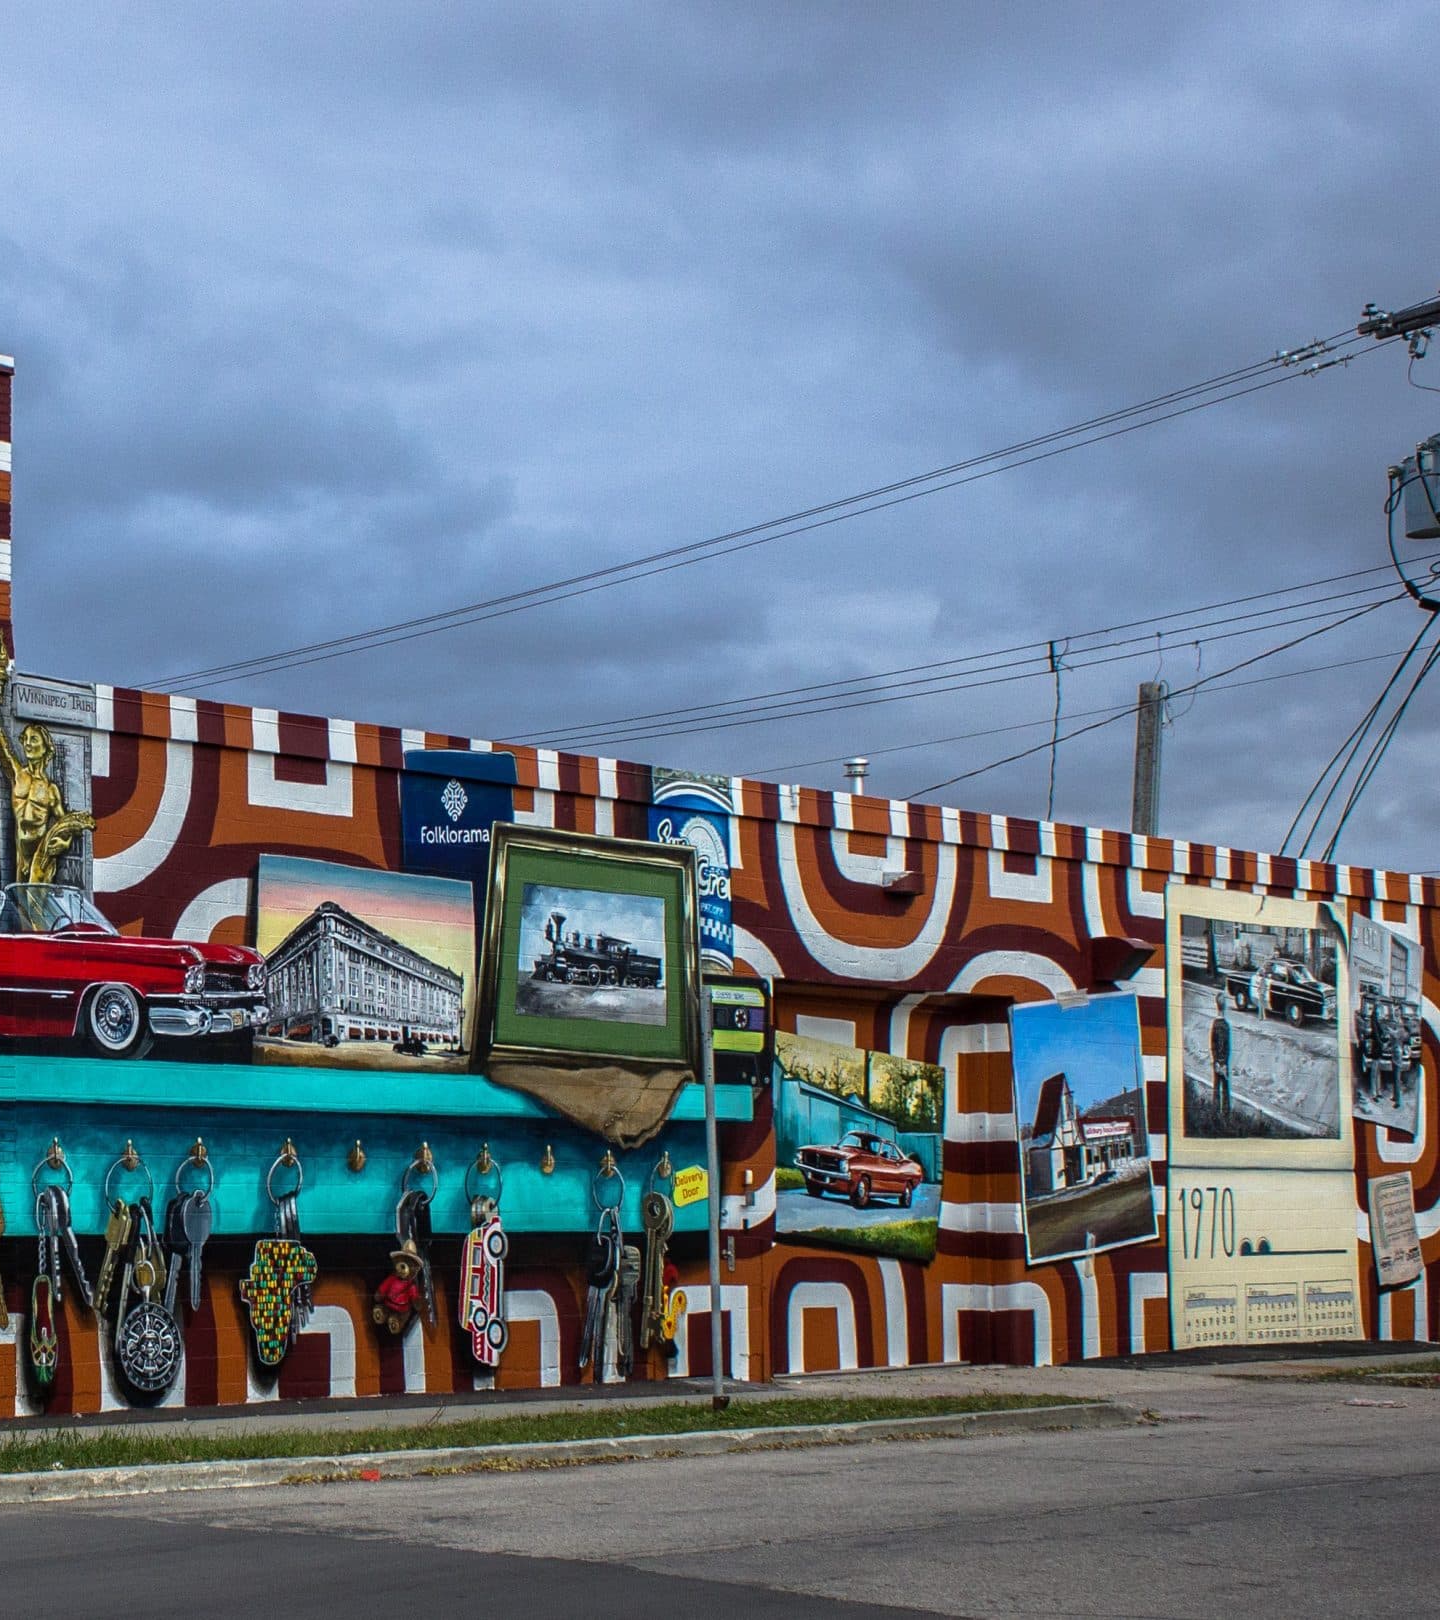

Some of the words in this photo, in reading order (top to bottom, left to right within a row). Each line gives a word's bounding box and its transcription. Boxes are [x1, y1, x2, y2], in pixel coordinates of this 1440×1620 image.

[421, 825, 490, 844] Folklorama
[675, 1172, 704, 1187] Delivery
[682, 1186, 700, 1199] Door
[1178, 1187, 1235, 1259] 1970
